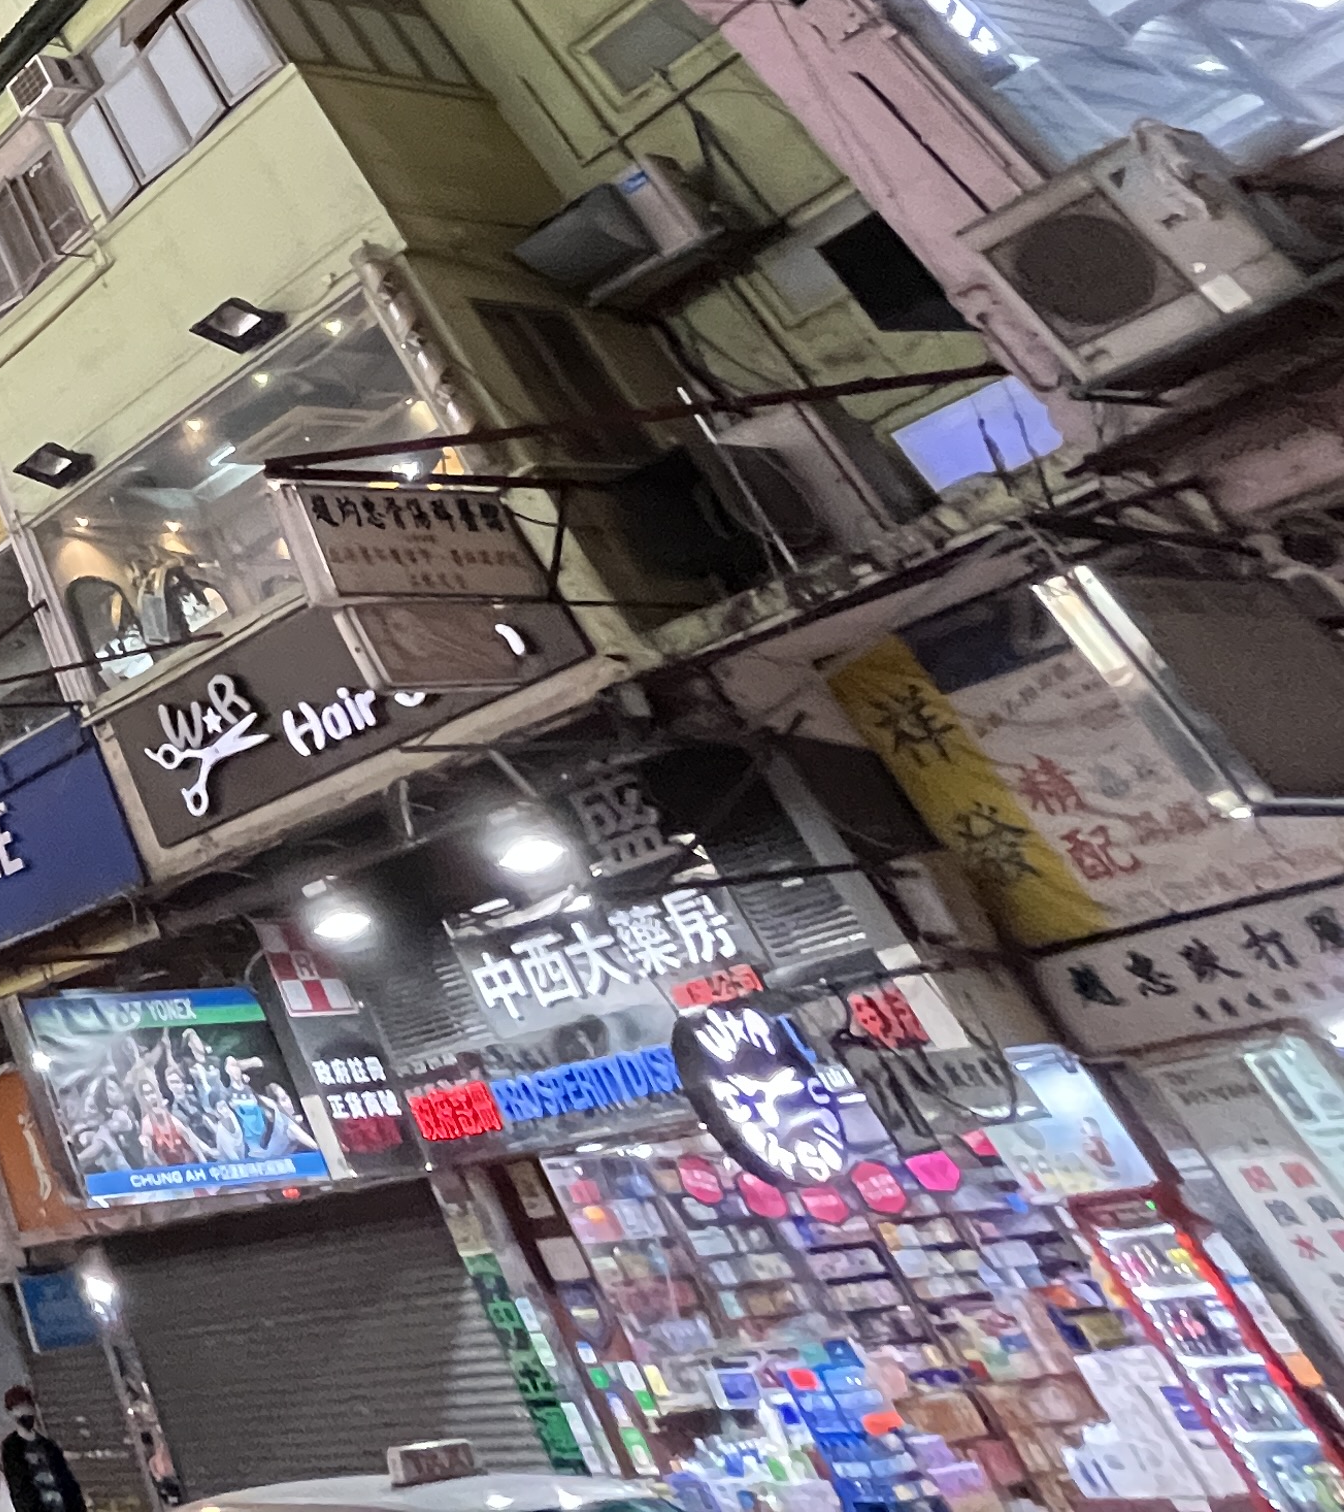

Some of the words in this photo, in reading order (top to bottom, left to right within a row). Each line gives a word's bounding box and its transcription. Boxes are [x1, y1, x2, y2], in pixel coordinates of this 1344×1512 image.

[283, 687, 377, 757] Hair
[472, 888, 738, 1020] 中西大藥房
[148, 998, 197, 1022] YONEX
[130, 1167, 184, 1188] CHUNG
[186, 1168, 207, 1183] AH
